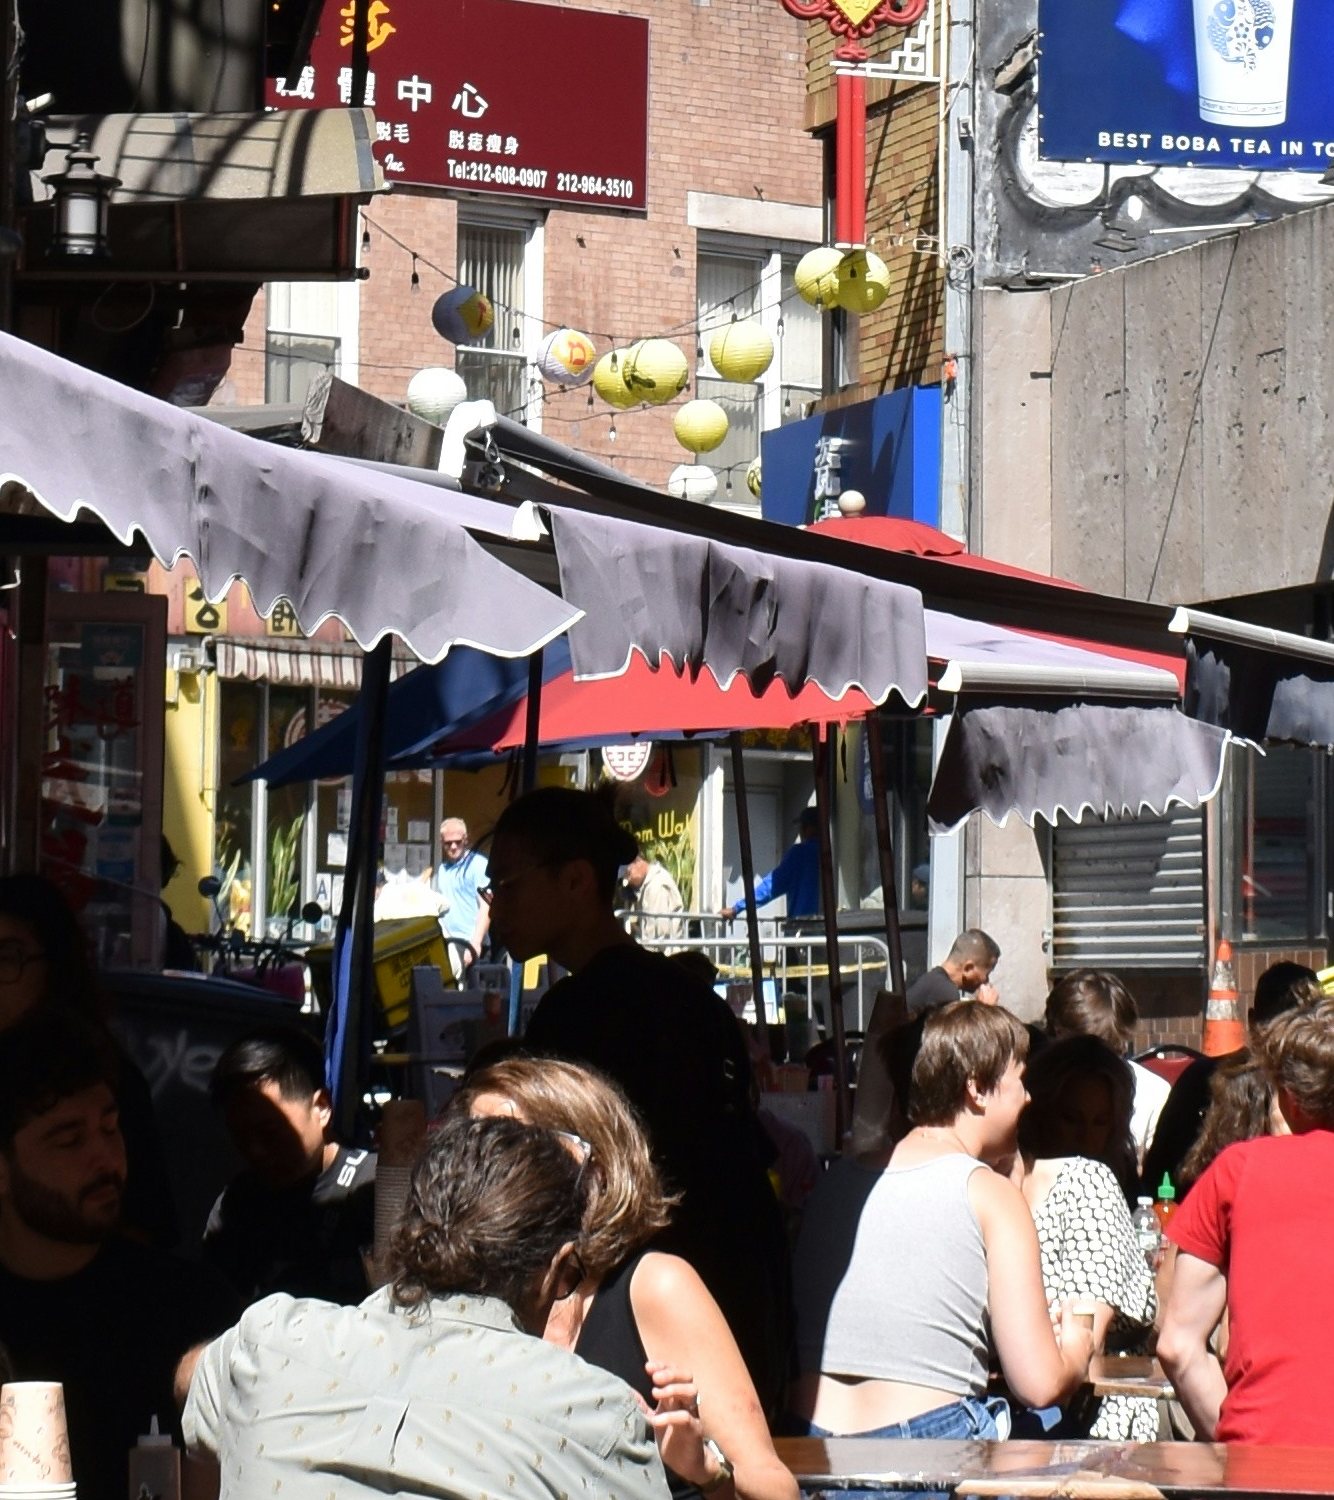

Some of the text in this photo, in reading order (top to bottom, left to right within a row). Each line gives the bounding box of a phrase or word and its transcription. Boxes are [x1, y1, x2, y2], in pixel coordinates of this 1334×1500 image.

[1098, 131, 1151, 149] BEST
[1161, 135, 1220, 152] BOBA
[1230, 138, 1271, 154] TEA
[1281, 141, 1303, 156] IN
[556, 172, 634, 199] 212-964-3510
